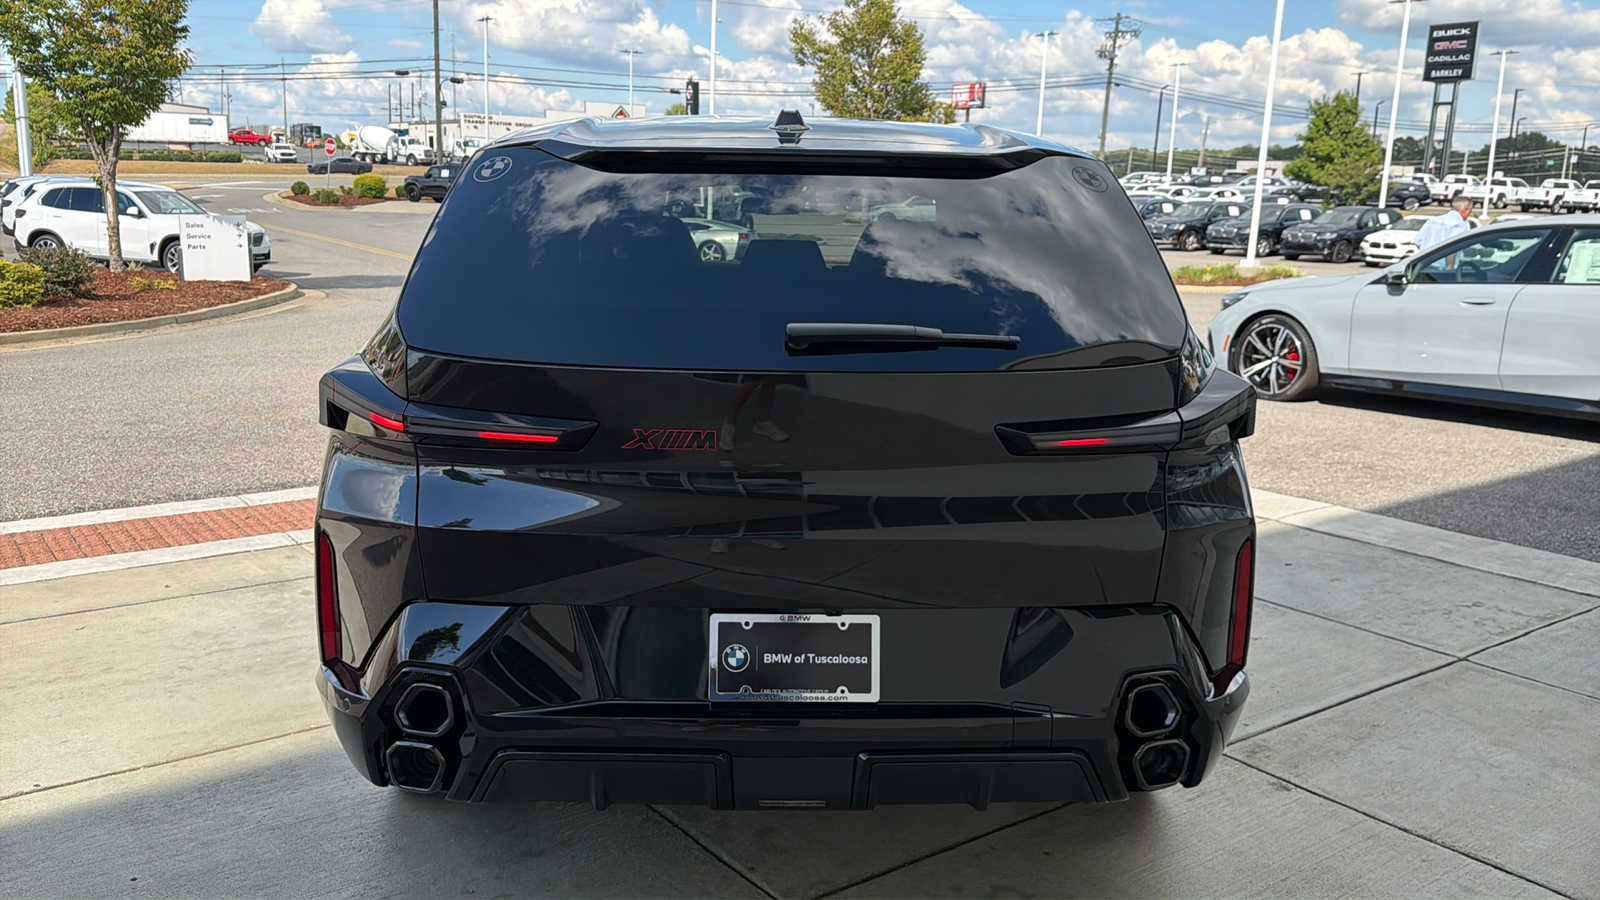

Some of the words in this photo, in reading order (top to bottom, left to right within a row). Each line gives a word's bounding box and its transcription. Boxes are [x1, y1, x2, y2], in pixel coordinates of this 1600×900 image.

[1432, 28, 1471, 37] BUICK
[1434, 40, 1468, 50] GMC
[1428, 54, 1470, 62] CADILLAC
[1430, 69, 1463, 78] BARKLEY
[764, 653, 792, 664] BMW
[794, 653, 806, 664] of
[807, 653, 868, 664] Tuscaloosa
